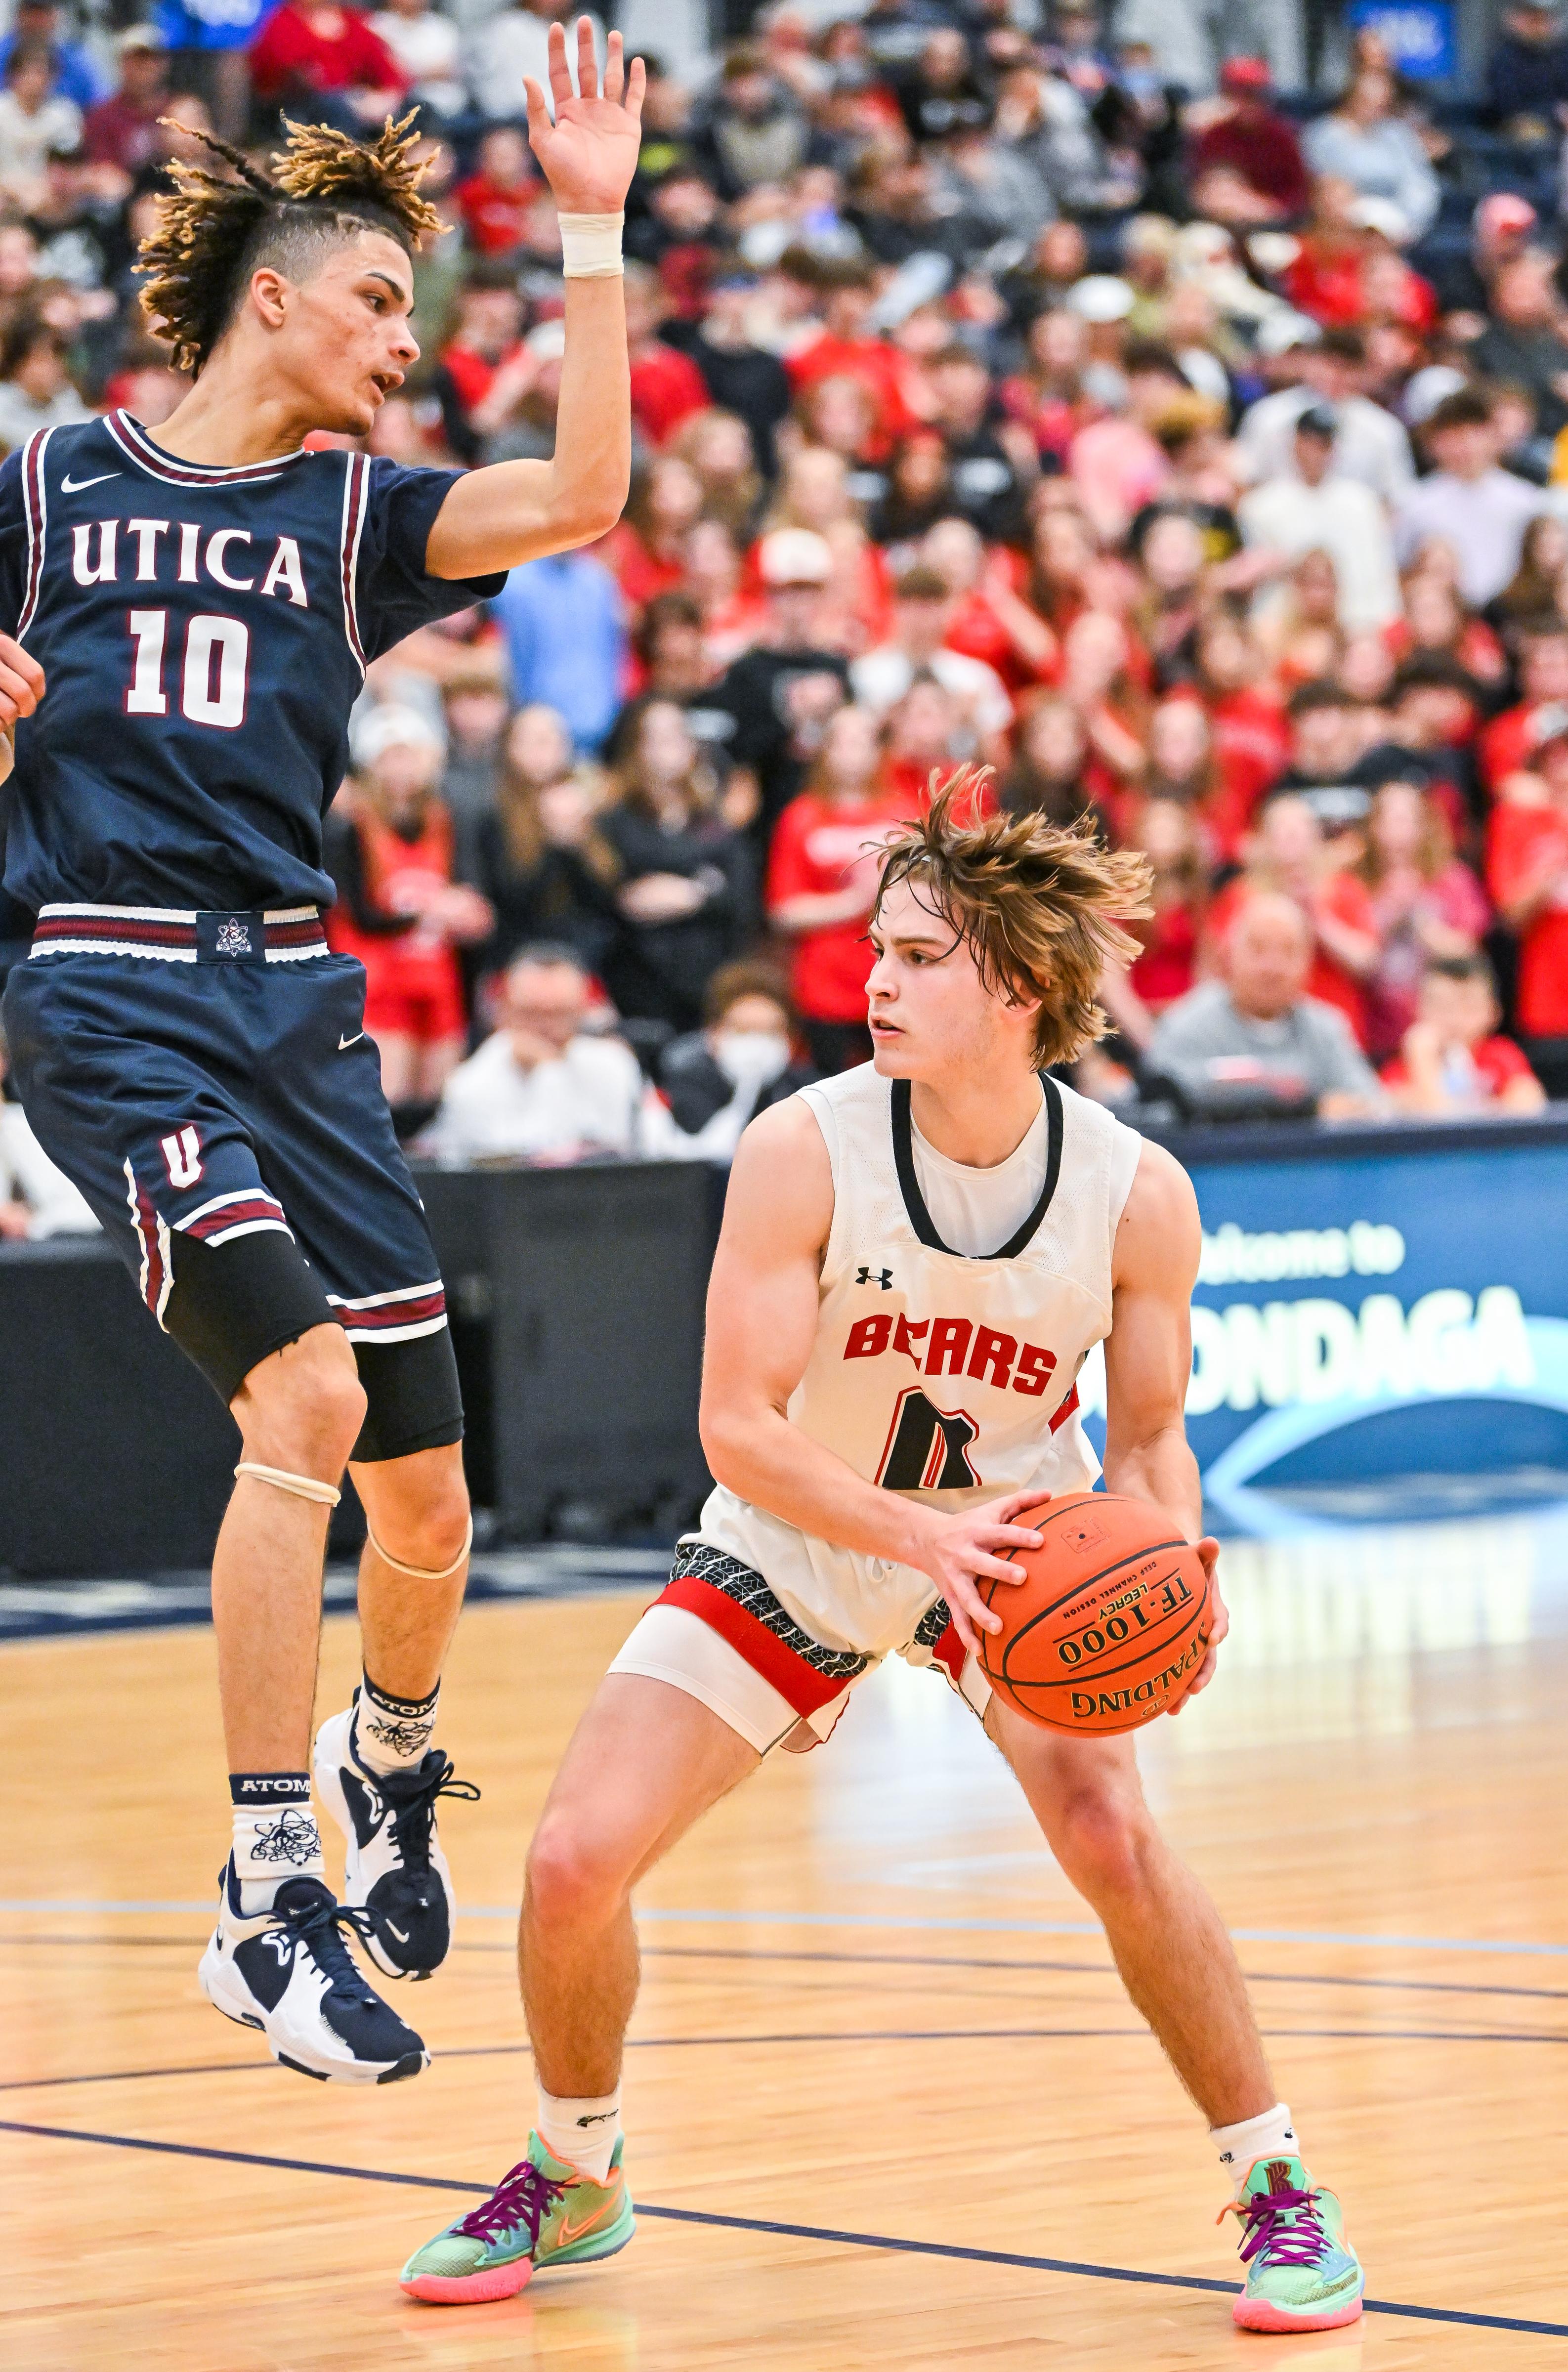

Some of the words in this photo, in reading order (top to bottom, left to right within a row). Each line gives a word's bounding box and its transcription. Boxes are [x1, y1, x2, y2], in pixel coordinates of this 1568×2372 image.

[72, 519, 308, 608] UTICA
[126, 608, 249, 729] 10
[159, 1123, 205, 1191] U
[843, 1312, 1057, 1397] BEARS
[1185, 1286, 1538, 1415] ONDAGA
[1099, 1581, 1149, 1623] LEGACY
[1100, 1574, 1137, 1599] CHANNEL
[1141, 1561, 1157, 1575] DEEP
[1058, 1575, 1192, 1665] TF-1000
[1063, 1598, 1097, 1619] DESIGN
[241, 1779, 310, 1793] ATOM
